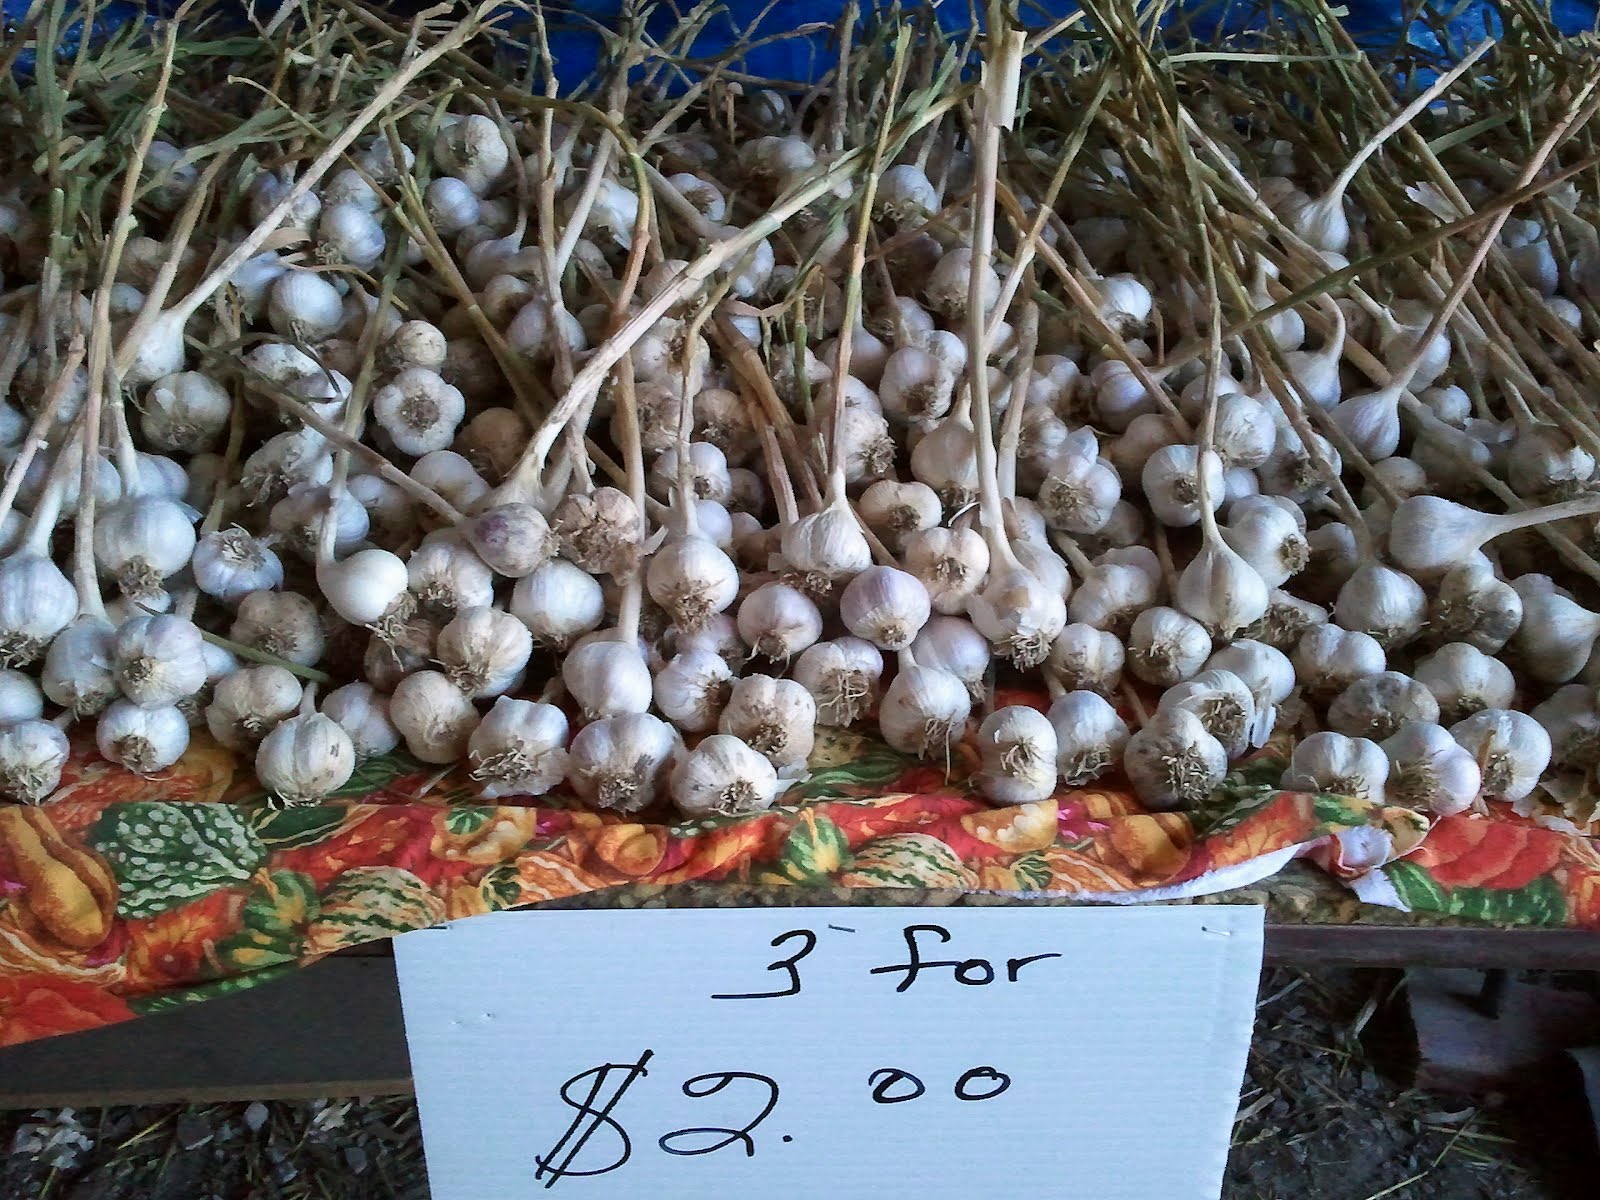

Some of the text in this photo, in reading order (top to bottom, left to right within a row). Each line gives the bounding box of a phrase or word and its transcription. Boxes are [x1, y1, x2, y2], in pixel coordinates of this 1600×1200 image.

[710, 924, 1063, 1000] 3 for
[534, 1048, 1011, 1189] $2.00
